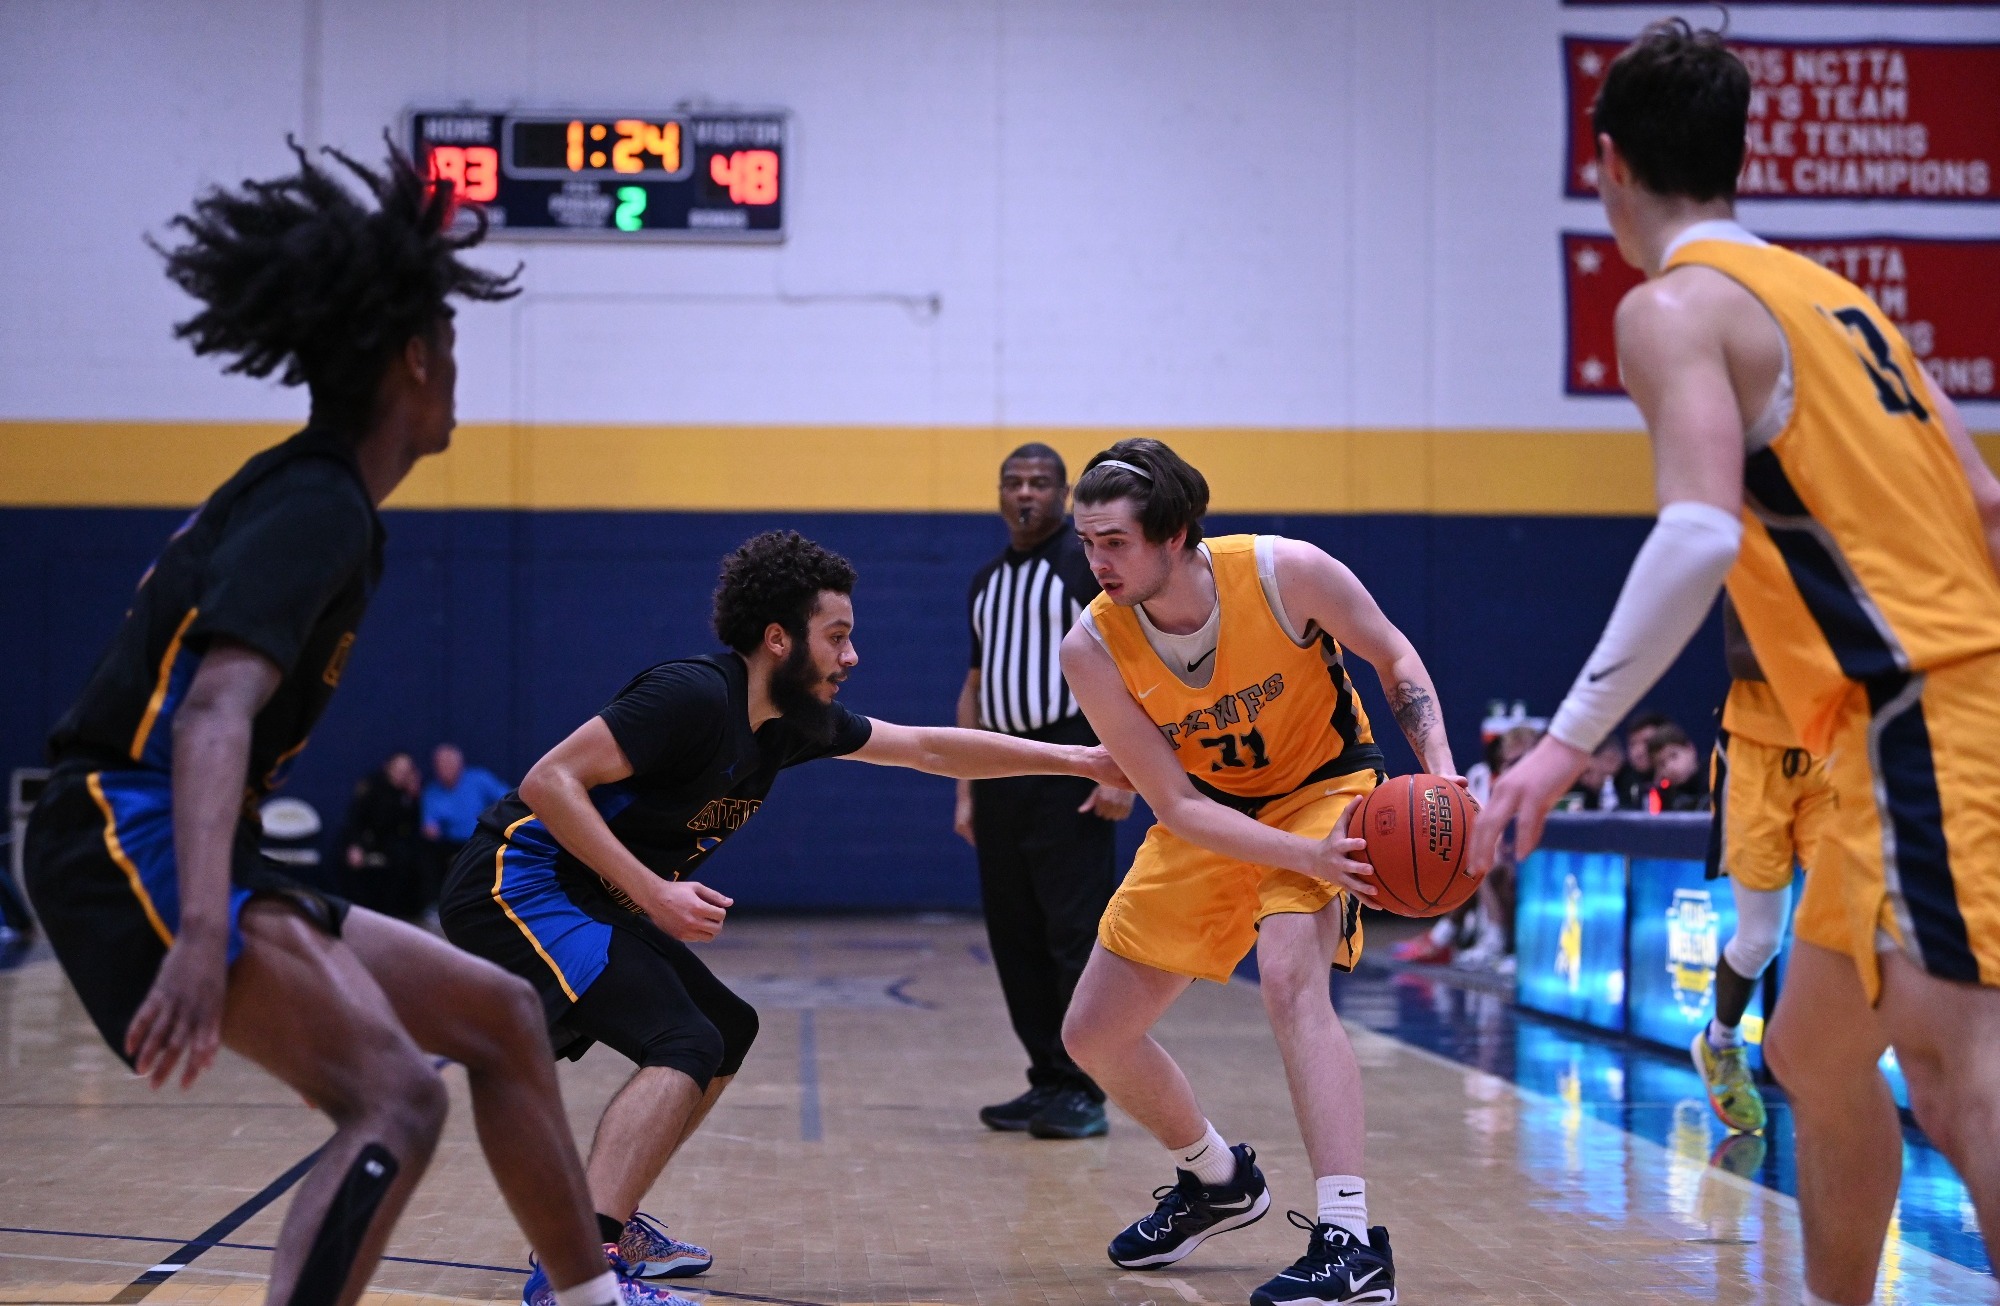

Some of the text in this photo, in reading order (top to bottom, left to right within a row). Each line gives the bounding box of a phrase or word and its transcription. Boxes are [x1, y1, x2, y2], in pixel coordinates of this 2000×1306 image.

[1793, 50, 1907, 84] NCTTA
[1814, 86, 1908, 119] TEAM
[567, 120, 680, 173] 1:24
[1803, 122, 1928, 157] TENNIS
[710, 149, 778, 204] 48
[1793, 159, 1990, 195] CHAMPIONS
[615, 186, 647, 232] 2
[1435, 786, 1452, 862] LEGACY
